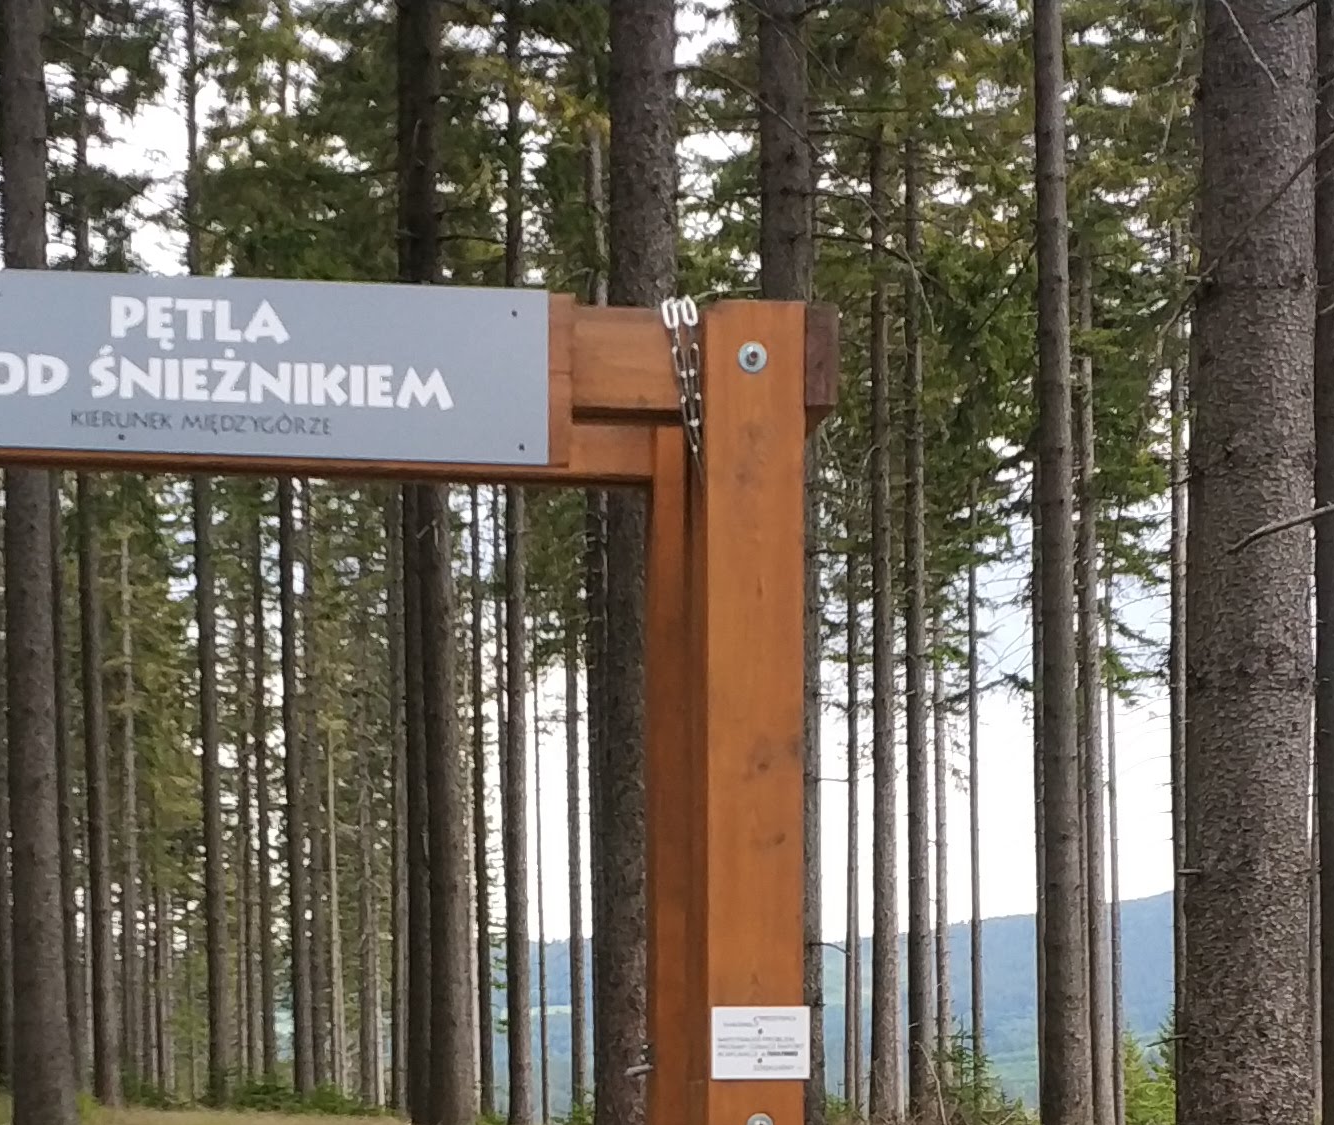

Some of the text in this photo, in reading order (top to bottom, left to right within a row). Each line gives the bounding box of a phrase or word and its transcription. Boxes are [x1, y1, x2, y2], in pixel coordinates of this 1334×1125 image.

[110, 296, 290, 351] PĘTLA
[88, 344, 454, 411] ŚNIEŻNIKIEM
[70, 409, 333, 436] KIERUNEK MIĘDZYGÓRZE
